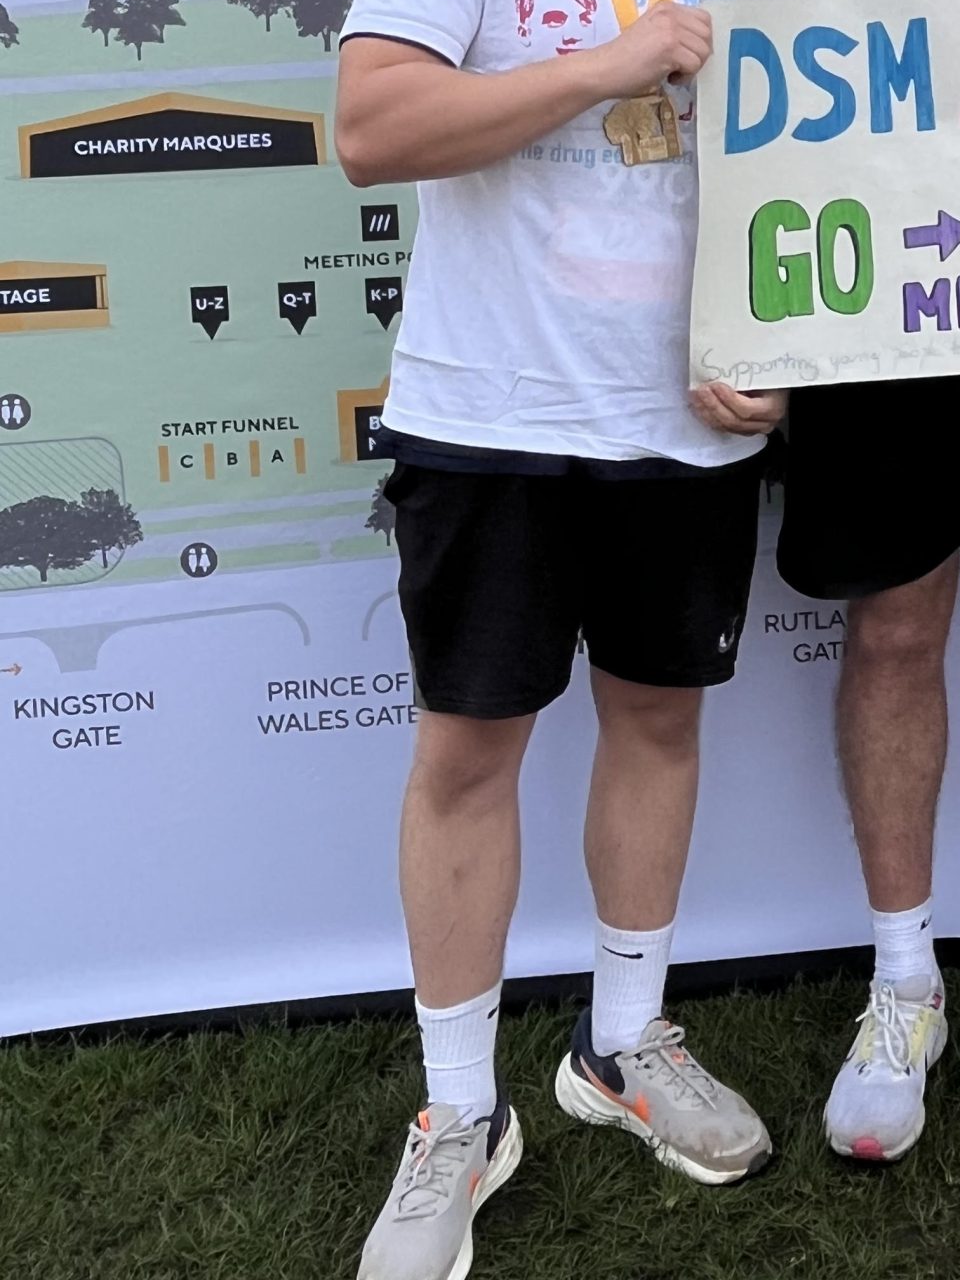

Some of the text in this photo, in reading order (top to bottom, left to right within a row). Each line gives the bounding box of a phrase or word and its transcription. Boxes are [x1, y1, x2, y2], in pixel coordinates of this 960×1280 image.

[725, 18, 936, 154] DSM
[74, 133, 272, 155] CHARITY MARQUEES
[550, 141, 596, 168] drug
[304, 251, 390, 269] MEETING
[749, 198, 874, 322] GO
[0, 288, 51, 304] TAGE
[195, 296, 225, 311] U-Z
[283, 291, 312, 307] Q-T
[370, 287, 398, 302] K-P
[702, 349, 819, 389] Supporting
[161, 417, 300, 437] START FUNNEL
[180, 455, 194, 469] C
[227, 452, 238, 465] B
[271, 449, 284, 463] A
[765, 610, 845, 633] RUTLA
[793, 641, 842, 662] GAT
[267, 672, 409, 702] PRINCE OF
[13, 691, 155, 719] KINGSTON
[257, 704, 418, 735] WALES GATE
[52, 725, 122, 749] GATE
